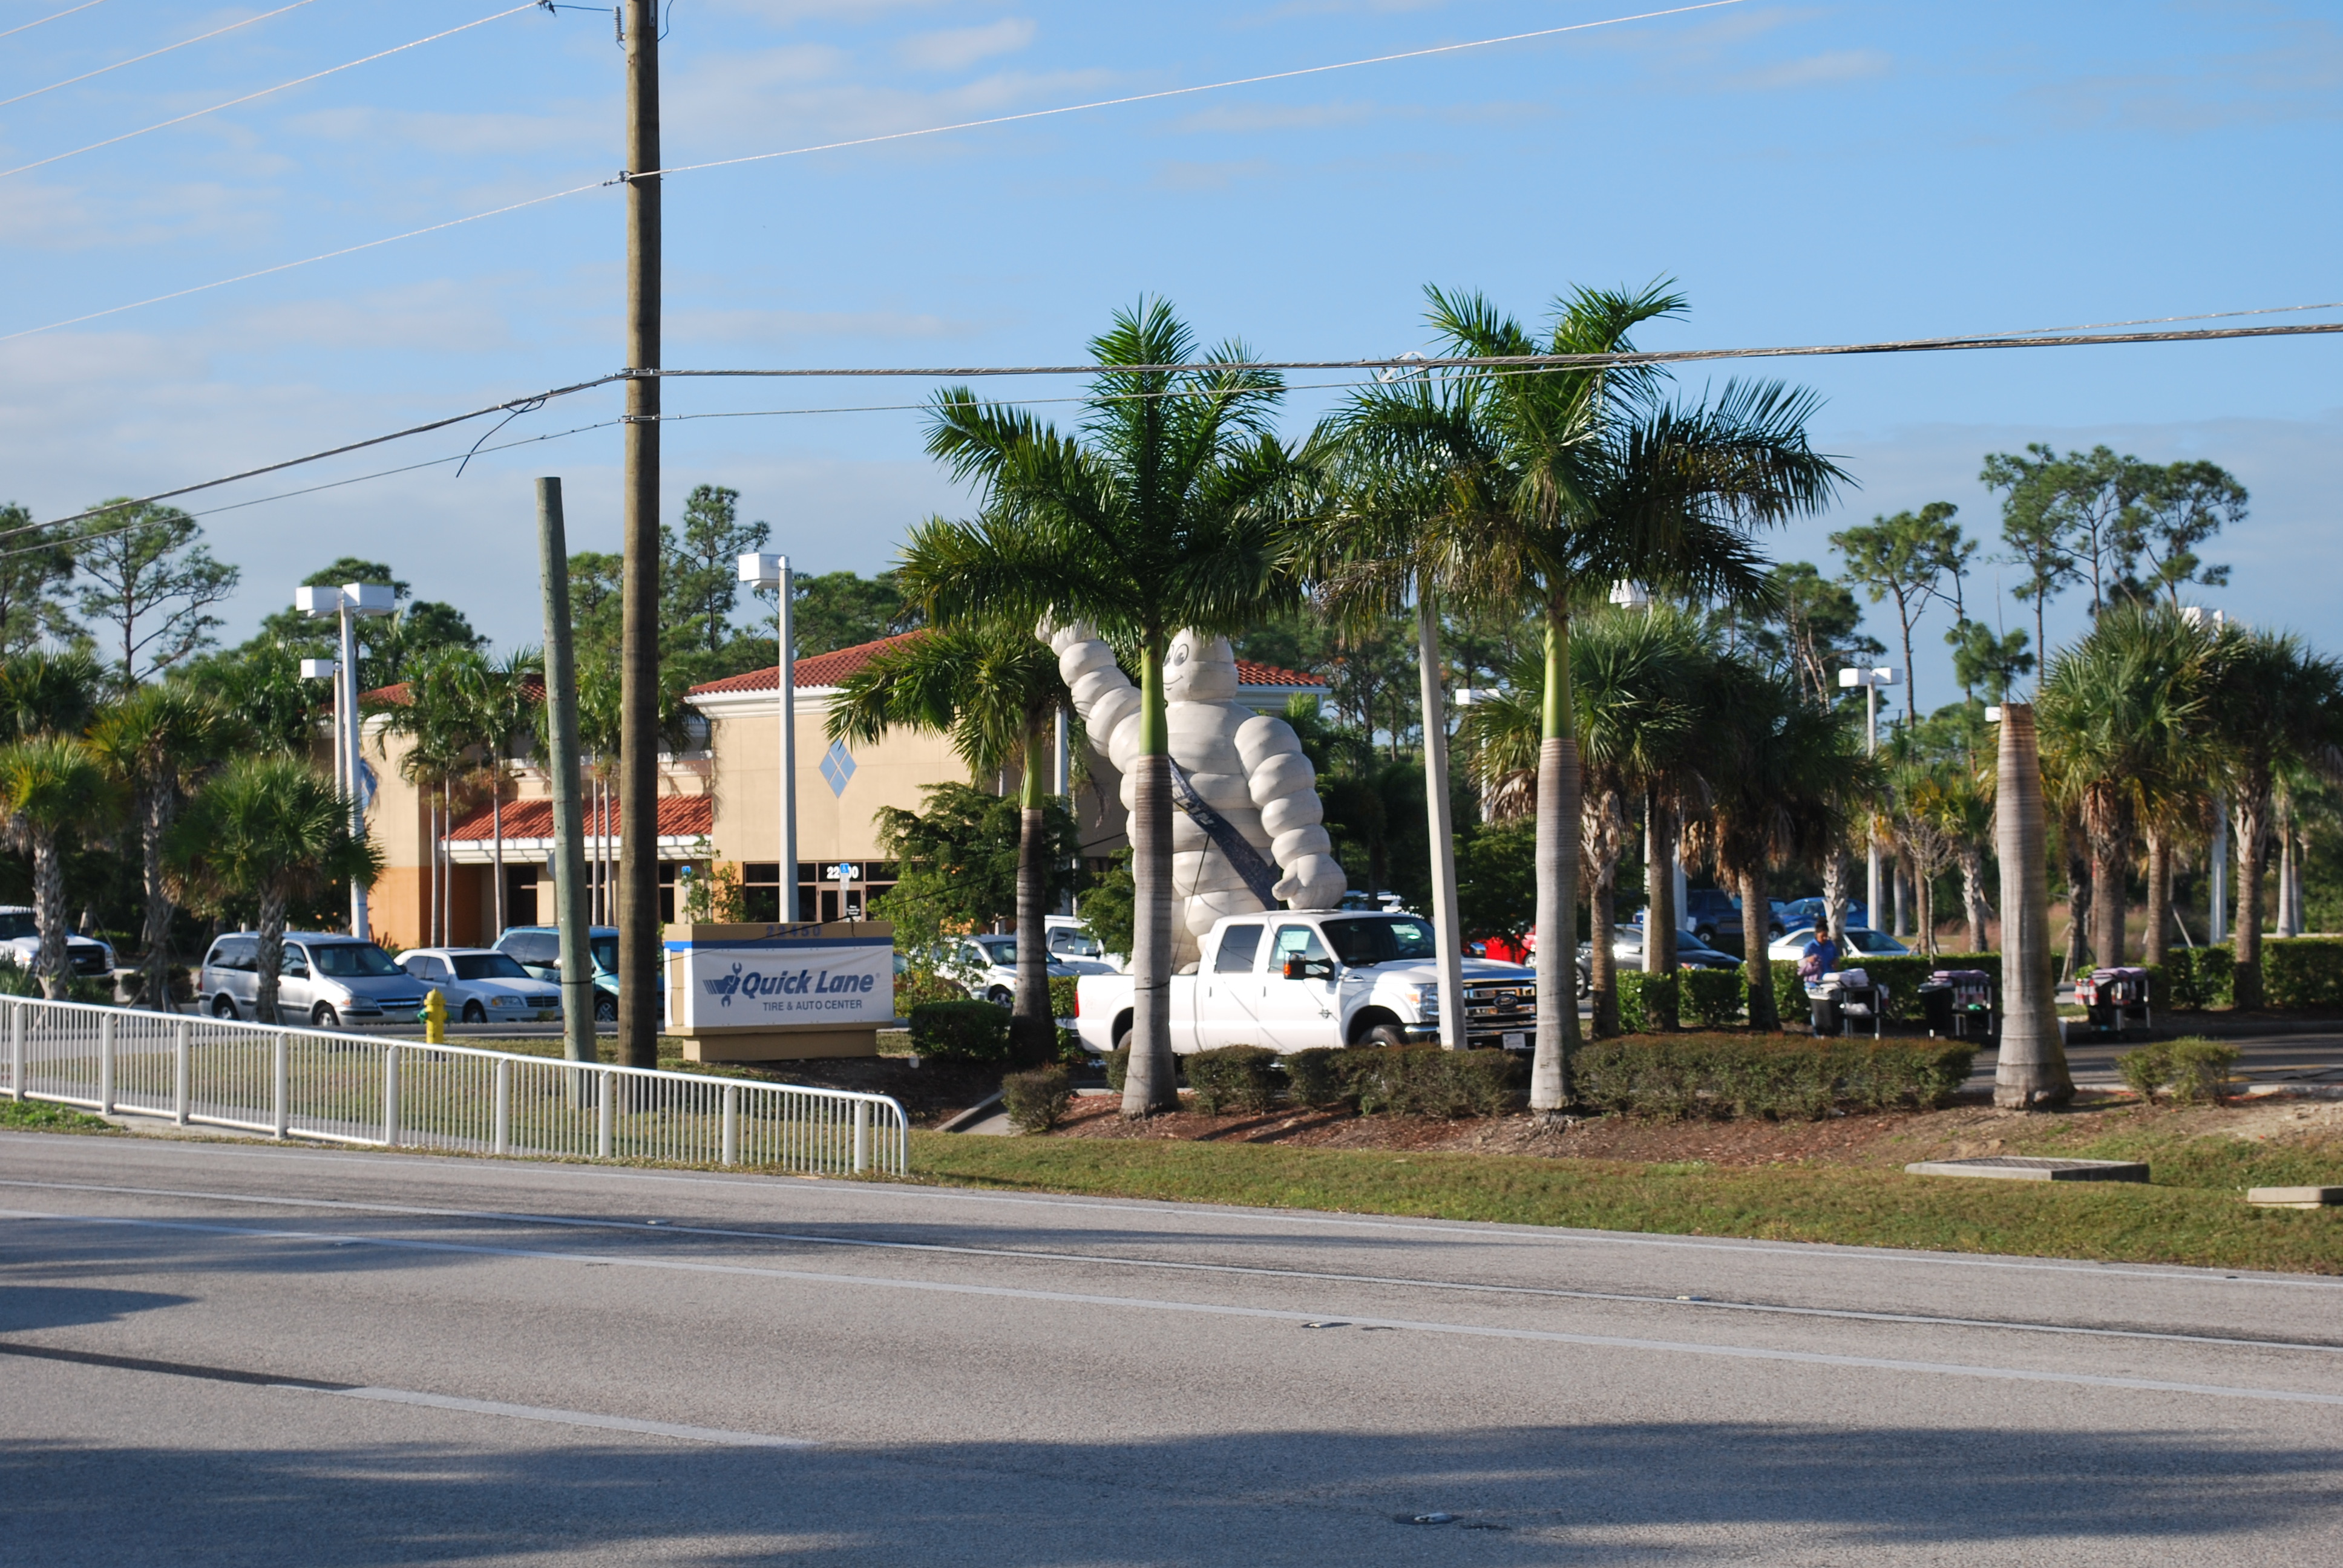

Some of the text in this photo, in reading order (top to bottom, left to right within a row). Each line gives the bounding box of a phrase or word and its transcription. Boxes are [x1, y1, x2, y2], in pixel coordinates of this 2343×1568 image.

[741, 969, 874, 999] Quick Lane
[763, 999, 862, 1011] TIRE & AUTO CENTER
